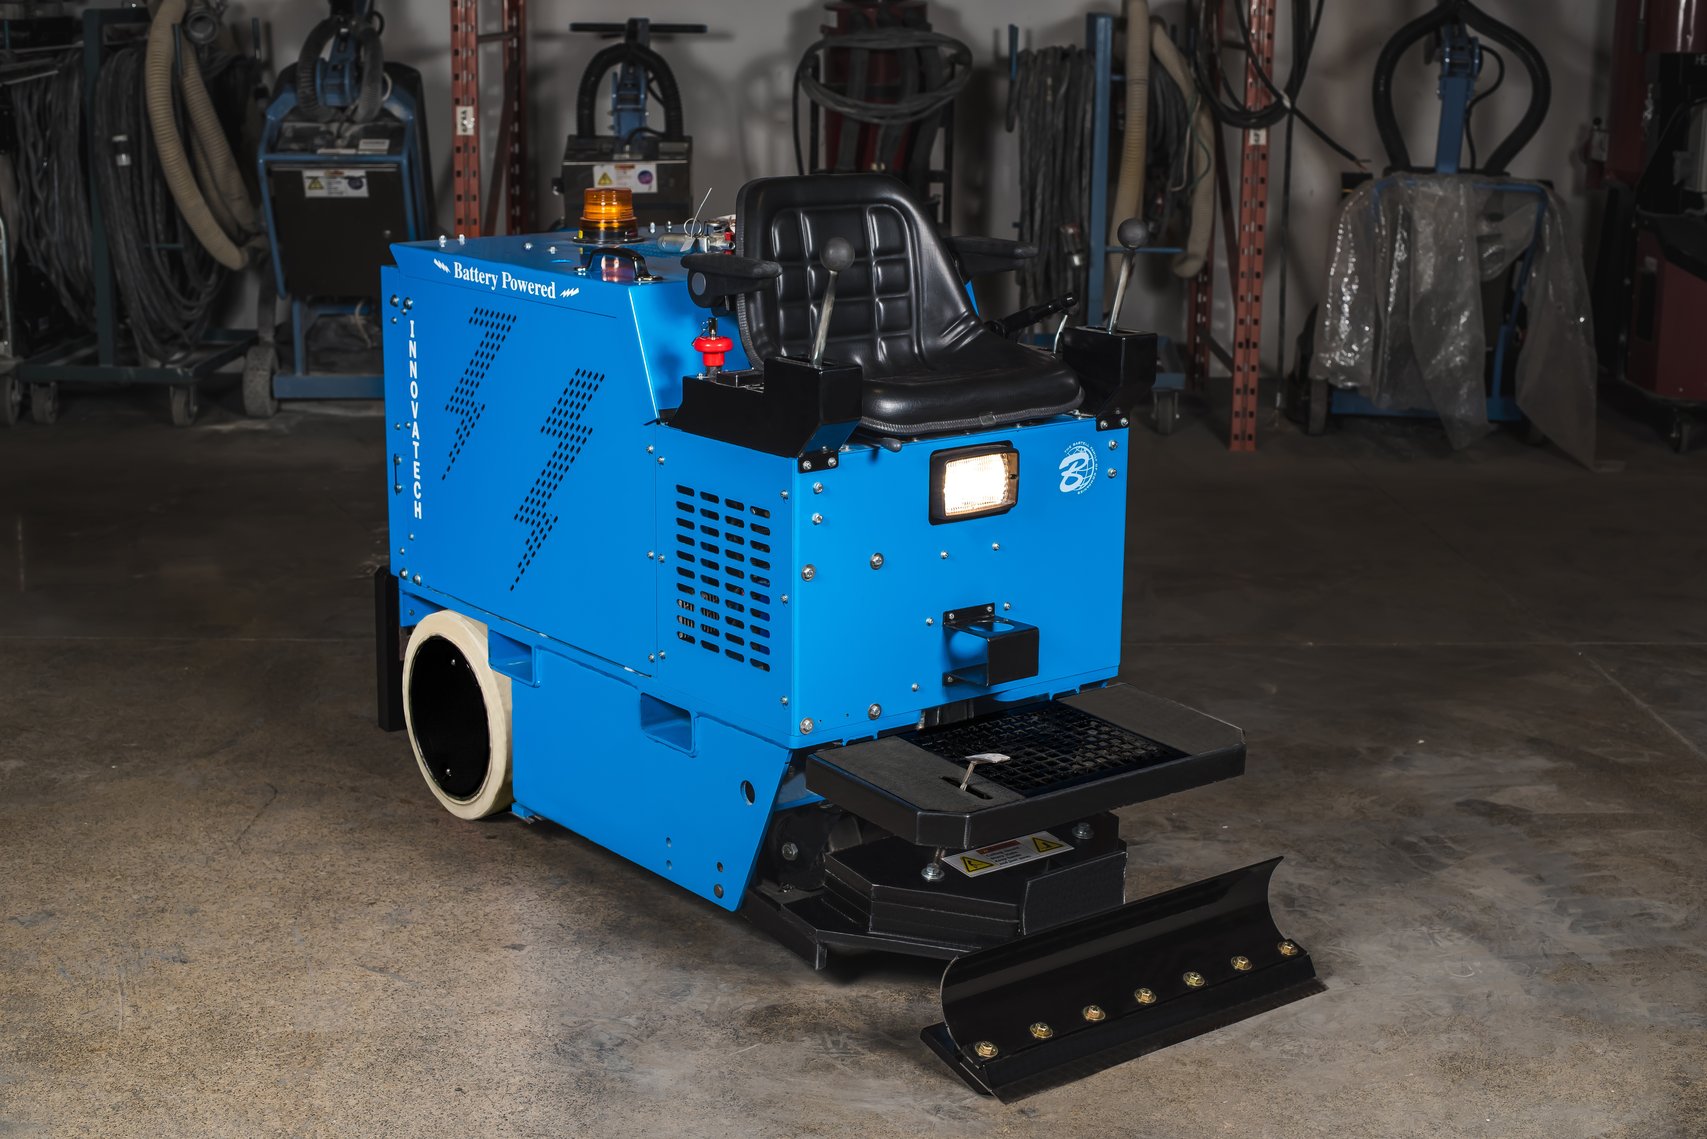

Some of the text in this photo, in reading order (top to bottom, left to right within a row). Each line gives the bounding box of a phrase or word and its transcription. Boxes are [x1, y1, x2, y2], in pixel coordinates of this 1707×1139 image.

[454, 262, 556, 298] Battery Powered
[409, 320, 422, 519] INNOVATECH
